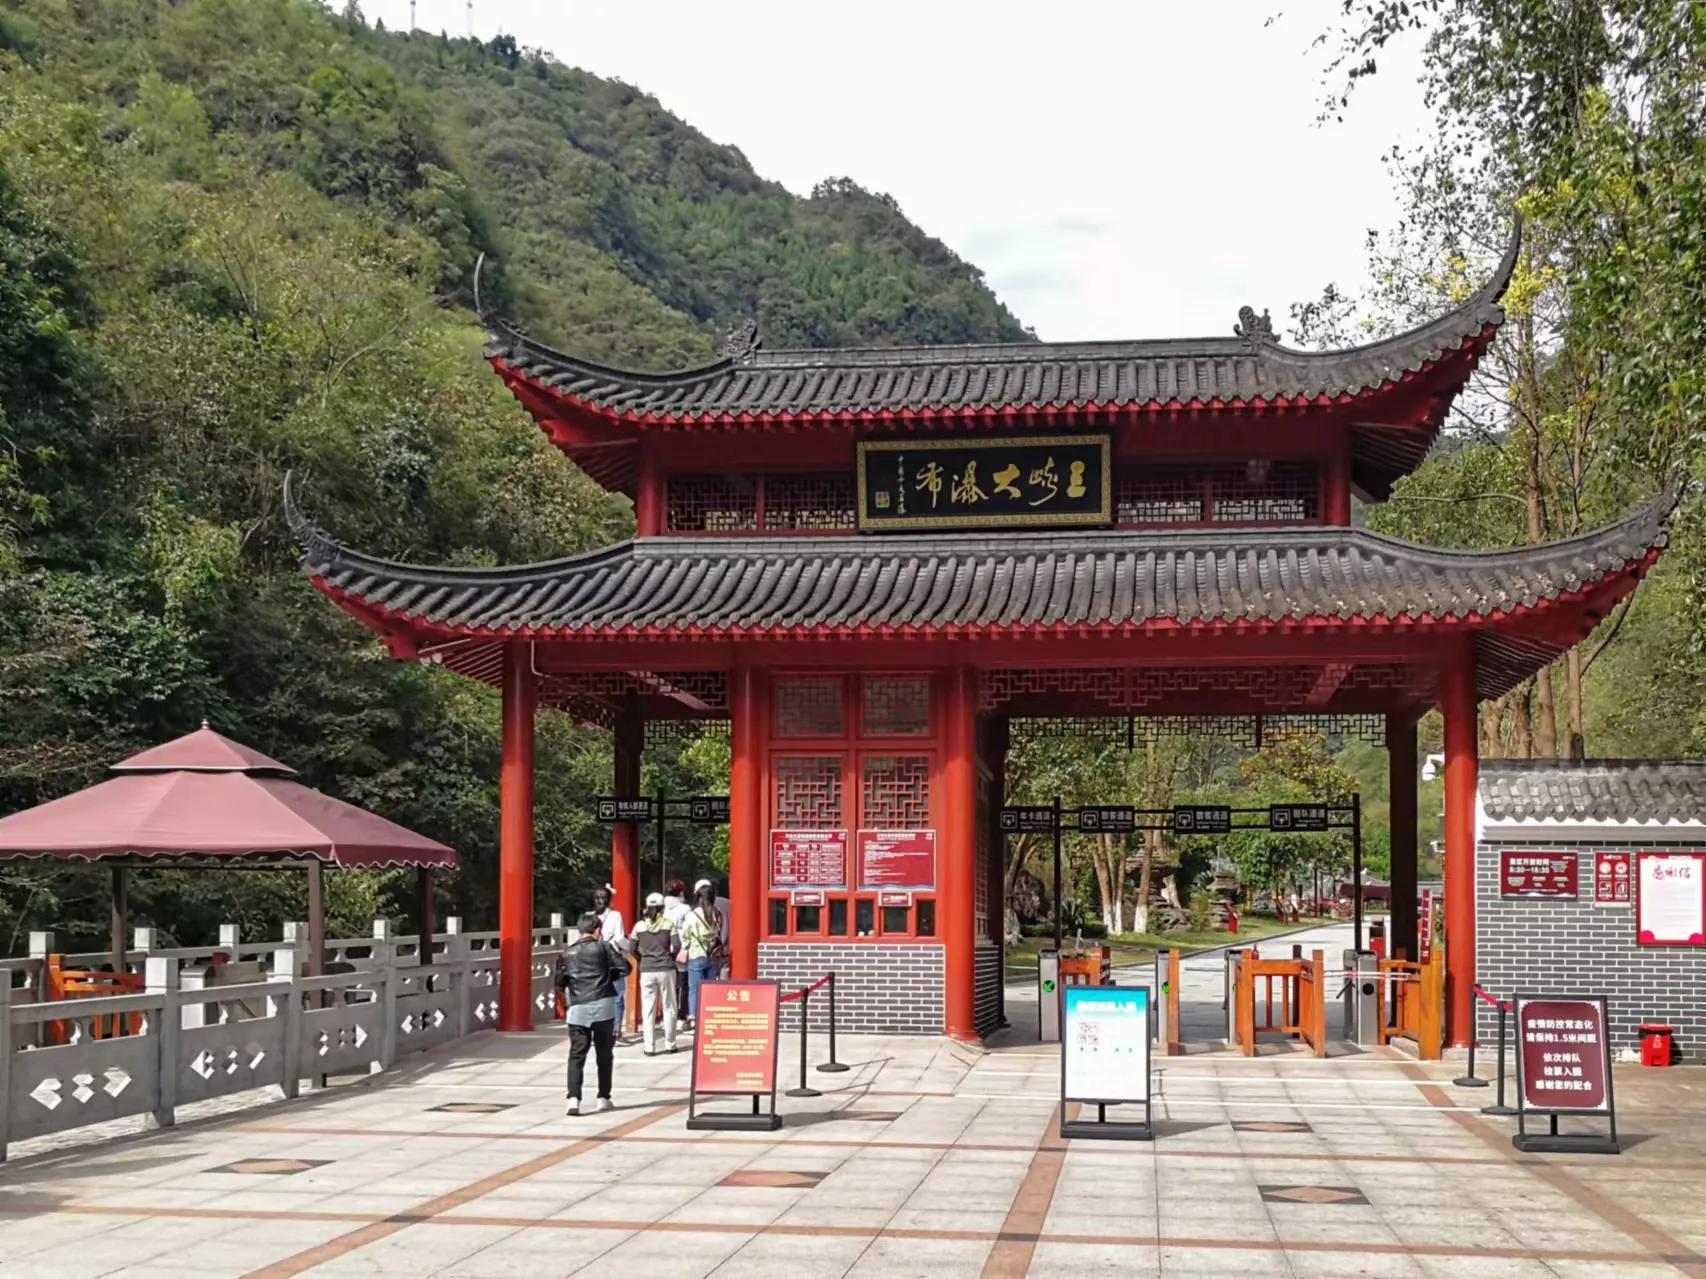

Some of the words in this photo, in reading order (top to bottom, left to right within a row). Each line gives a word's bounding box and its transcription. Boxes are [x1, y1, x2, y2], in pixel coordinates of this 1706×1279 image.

[1527, 1019, 1594, 1030] 疫情防控常态化
[1526, 1032, 1597, 1044] 请保持1.5米间距
[1543, 1052, 1582, 1063] 依次排队
[1543, 1066, 1583, 1077] 检票入园
[1535, 1080, 1593, 1091] 感谢您的配合
